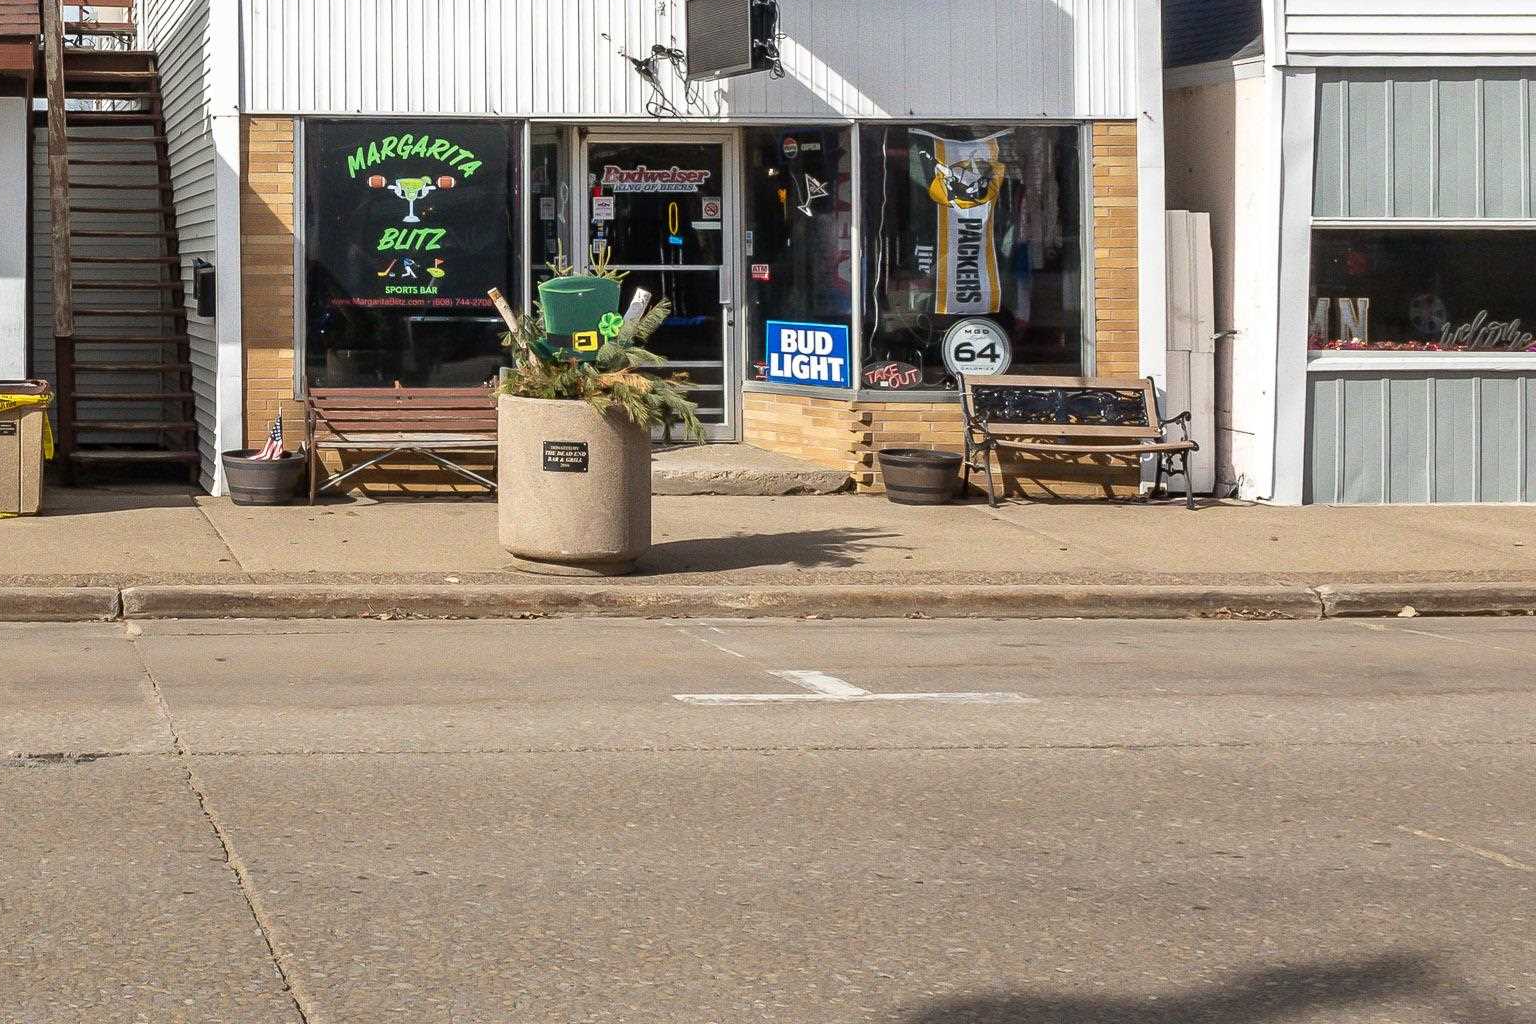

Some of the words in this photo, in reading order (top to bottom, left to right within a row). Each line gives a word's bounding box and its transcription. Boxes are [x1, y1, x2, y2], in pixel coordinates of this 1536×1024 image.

[347, 133, 483, 179] MARGARITA
[601, 165, 711, 184] Budweiser
[377, 227, 446, 251] BLITZ
[955, 217, 983, 304] PACKERS
[385, 286, 418, 295] SPORTS
[419, 286, 438, 295] BAR
[780, 328, 834, 356] BUD
[953, 341, 1001, 364] 64
[864, 363, 899, 385] TAKE
[888, 368, 918, 389] OUT
